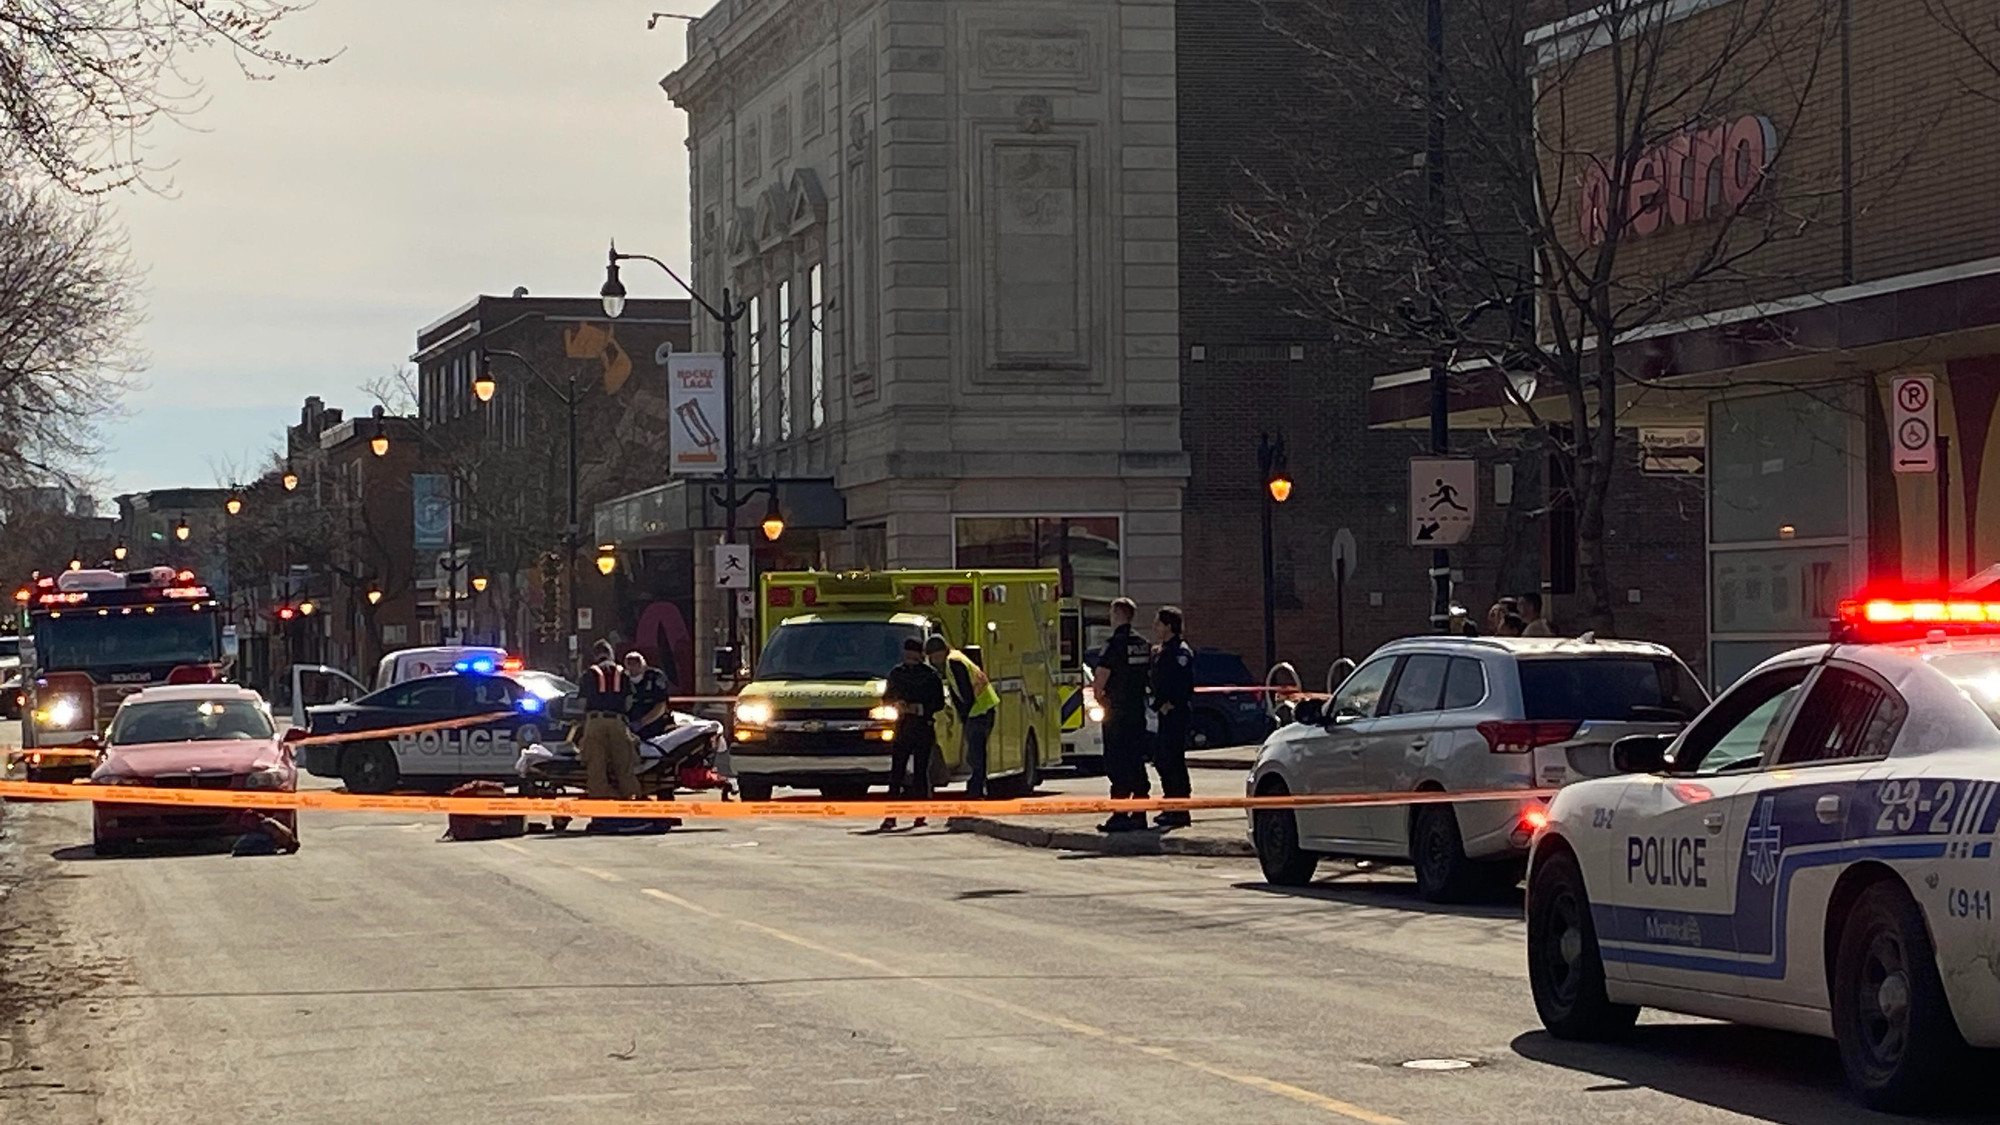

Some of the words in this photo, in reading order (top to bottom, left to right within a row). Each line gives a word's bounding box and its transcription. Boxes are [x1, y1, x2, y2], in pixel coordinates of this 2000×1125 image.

[397, 728, 513, 756] POLICE
[1592, 807, 1615, 830] 23-2
[1876, 780, 1956, 832] 23-2
[1627, 836, 1708, 888] POLICE
